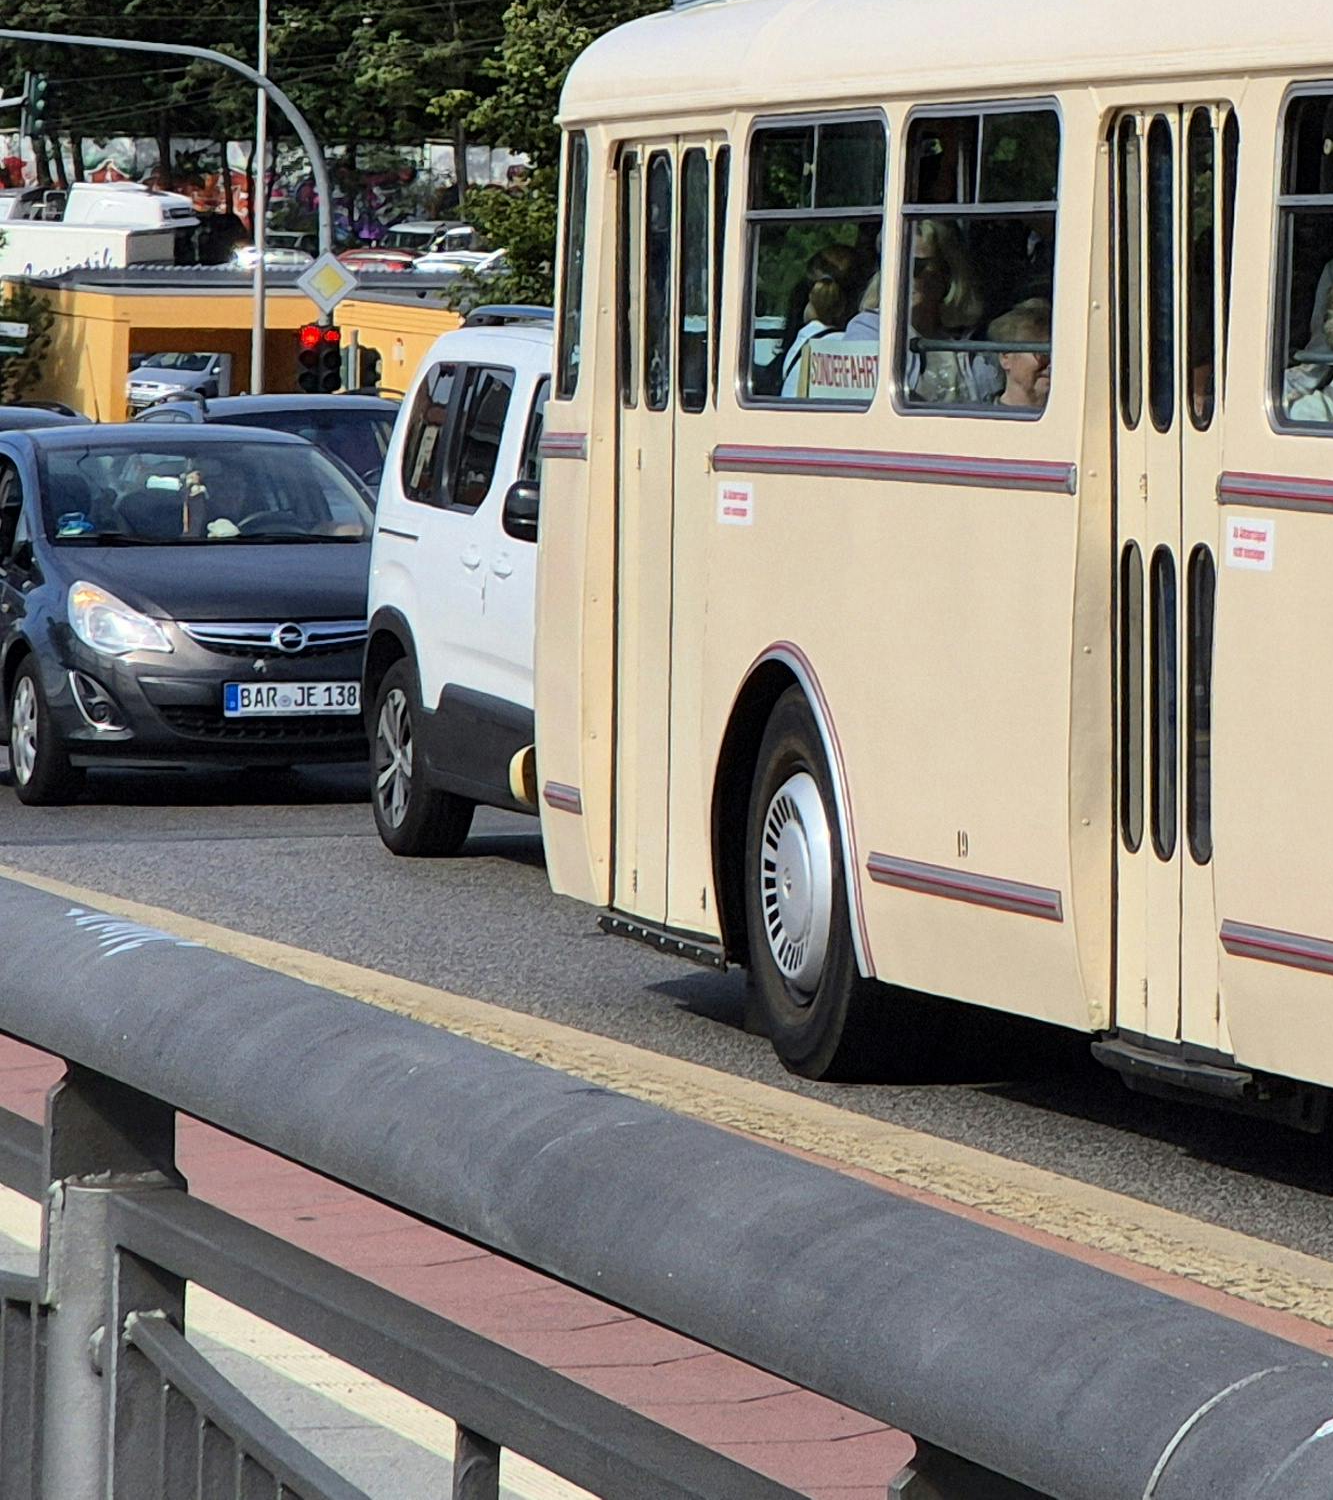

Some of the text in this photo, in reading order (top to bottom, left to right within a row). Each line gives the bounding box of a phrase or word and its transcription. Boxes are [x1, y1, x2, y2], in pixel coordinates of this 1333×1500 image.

[240, 685, 357, 708] BAR JE 138
[957, 830, 968, 858] 19
